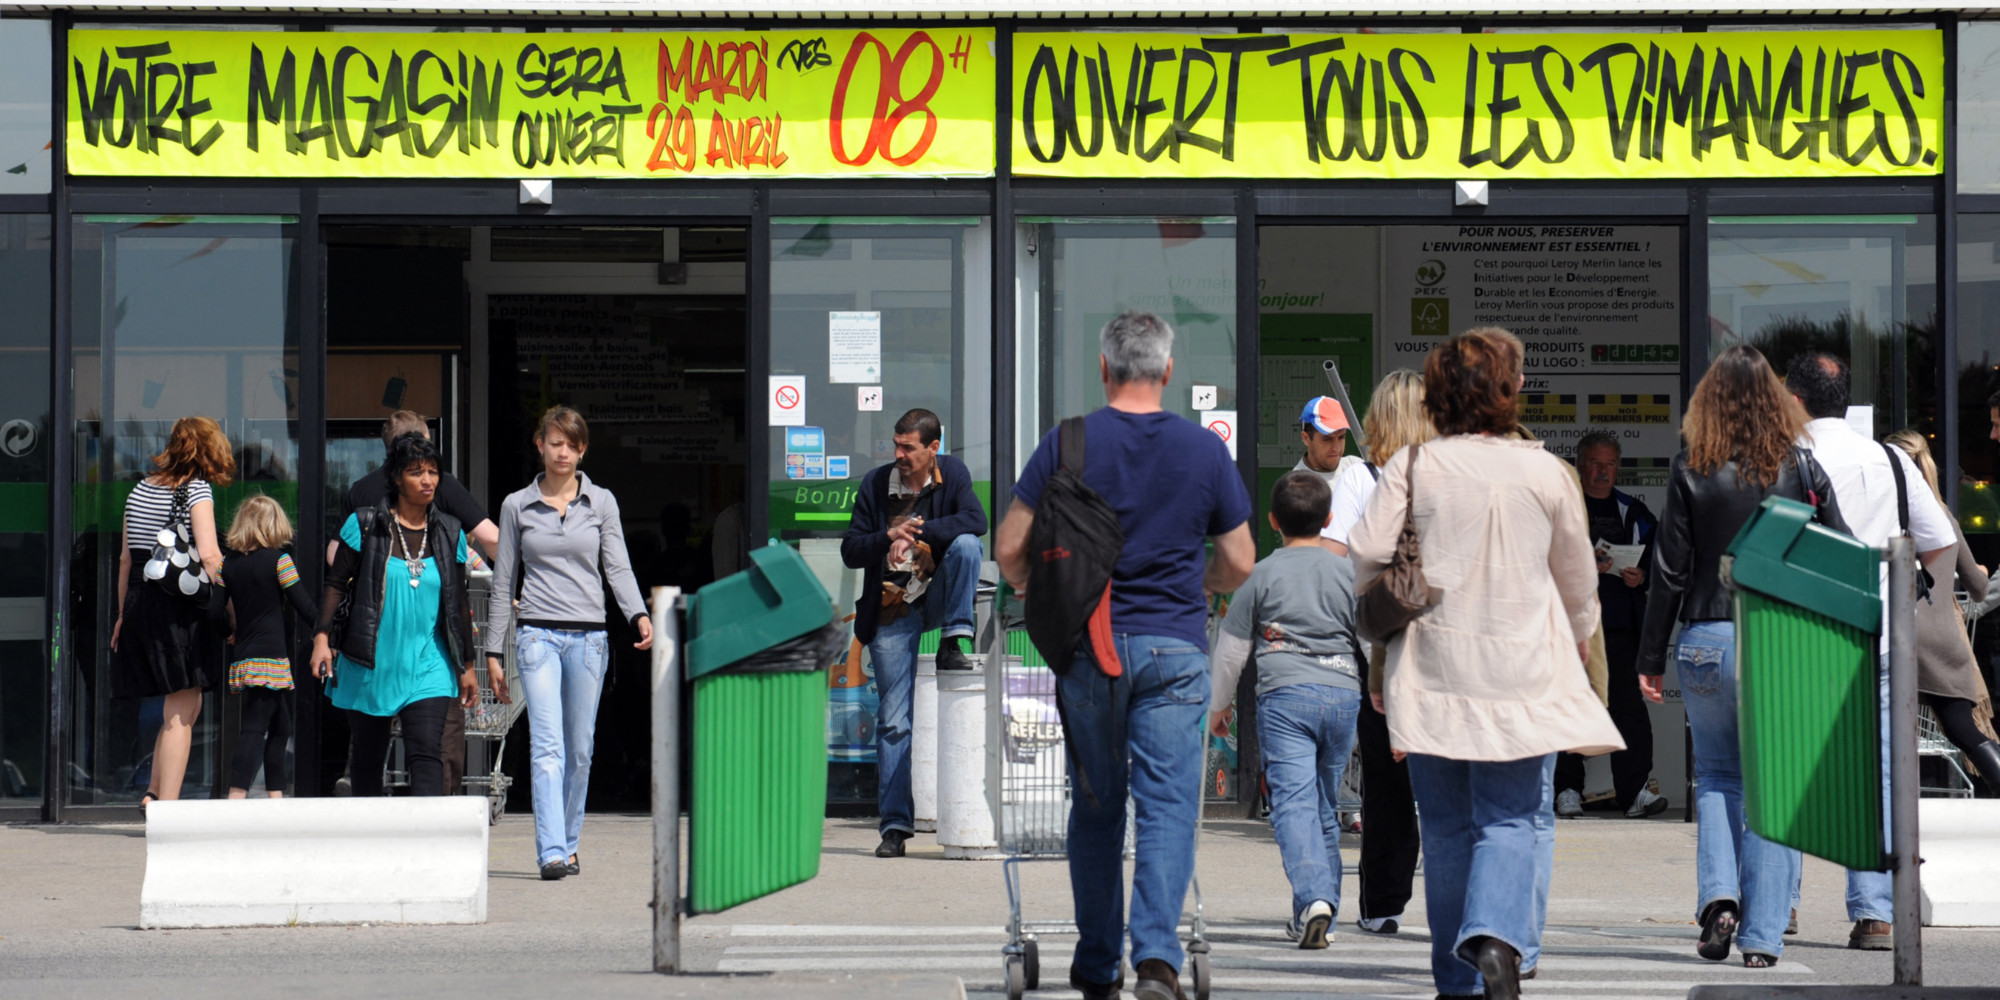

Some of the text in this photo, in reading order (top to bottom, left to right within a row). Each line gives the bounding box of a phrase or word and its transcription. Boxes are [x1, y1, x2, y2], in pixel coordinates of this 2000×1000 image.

[515, 42, 630, 102] SERA
[657, 35, 768, 105] MARDI
[73, 41, 504, 161] VOTRE MAGASIN
[829, 31, 945, 167] 08
[1022, 34, 1291, 164] OUVERT
[1266, 37, 1436, 164] TOUS
[1460, 43, 1575, 170] LES
[512, 103, 643, 169] OUVERT
[645, 103, 789, 172] 29 AVRIL
[1459, 227, 1494, 237] POUR
[1498, 227, 1537, 238] NOUS,
[1422, 242, 1546, 252] L'ENVIRONNEMENT
[1549, 242, 1572, 252] EST
[1574, 242, 1642, 252] ESSENTIEL
[1474, 259, 1662, 270] C'est pourquoi Leroy Merlin lance les
[1474, 273, 1649, 286] Initiatives pour le Développement
[1474, 287, 1660, 300] Durable et les Economies d'Energie.
[1474, 300, 1502, 310] Leroy
[1505, 299, 1538, 309] Merlin
[1568, 302, 1609, 311] propose
[1612, 299, 1629, 309] des
[1632, 299, 1675, 311] produits
[1474, 312, 1638, 323] respectueux de l'environnement
[1543, 326, 1581, 337] qualité.
[1395, 342, 1429, 352] VOUS
[1525, 342, 1585, 353] PRODUITS
[1543, 357, 1578, 368] LOGO
[1551, 415, 1576, 423] PRIX
[1645, 415, 1670, 423] PRIX
[1624, 430, 1640, 438] ou
[1010, 722, 1065, 740] REFLEX
